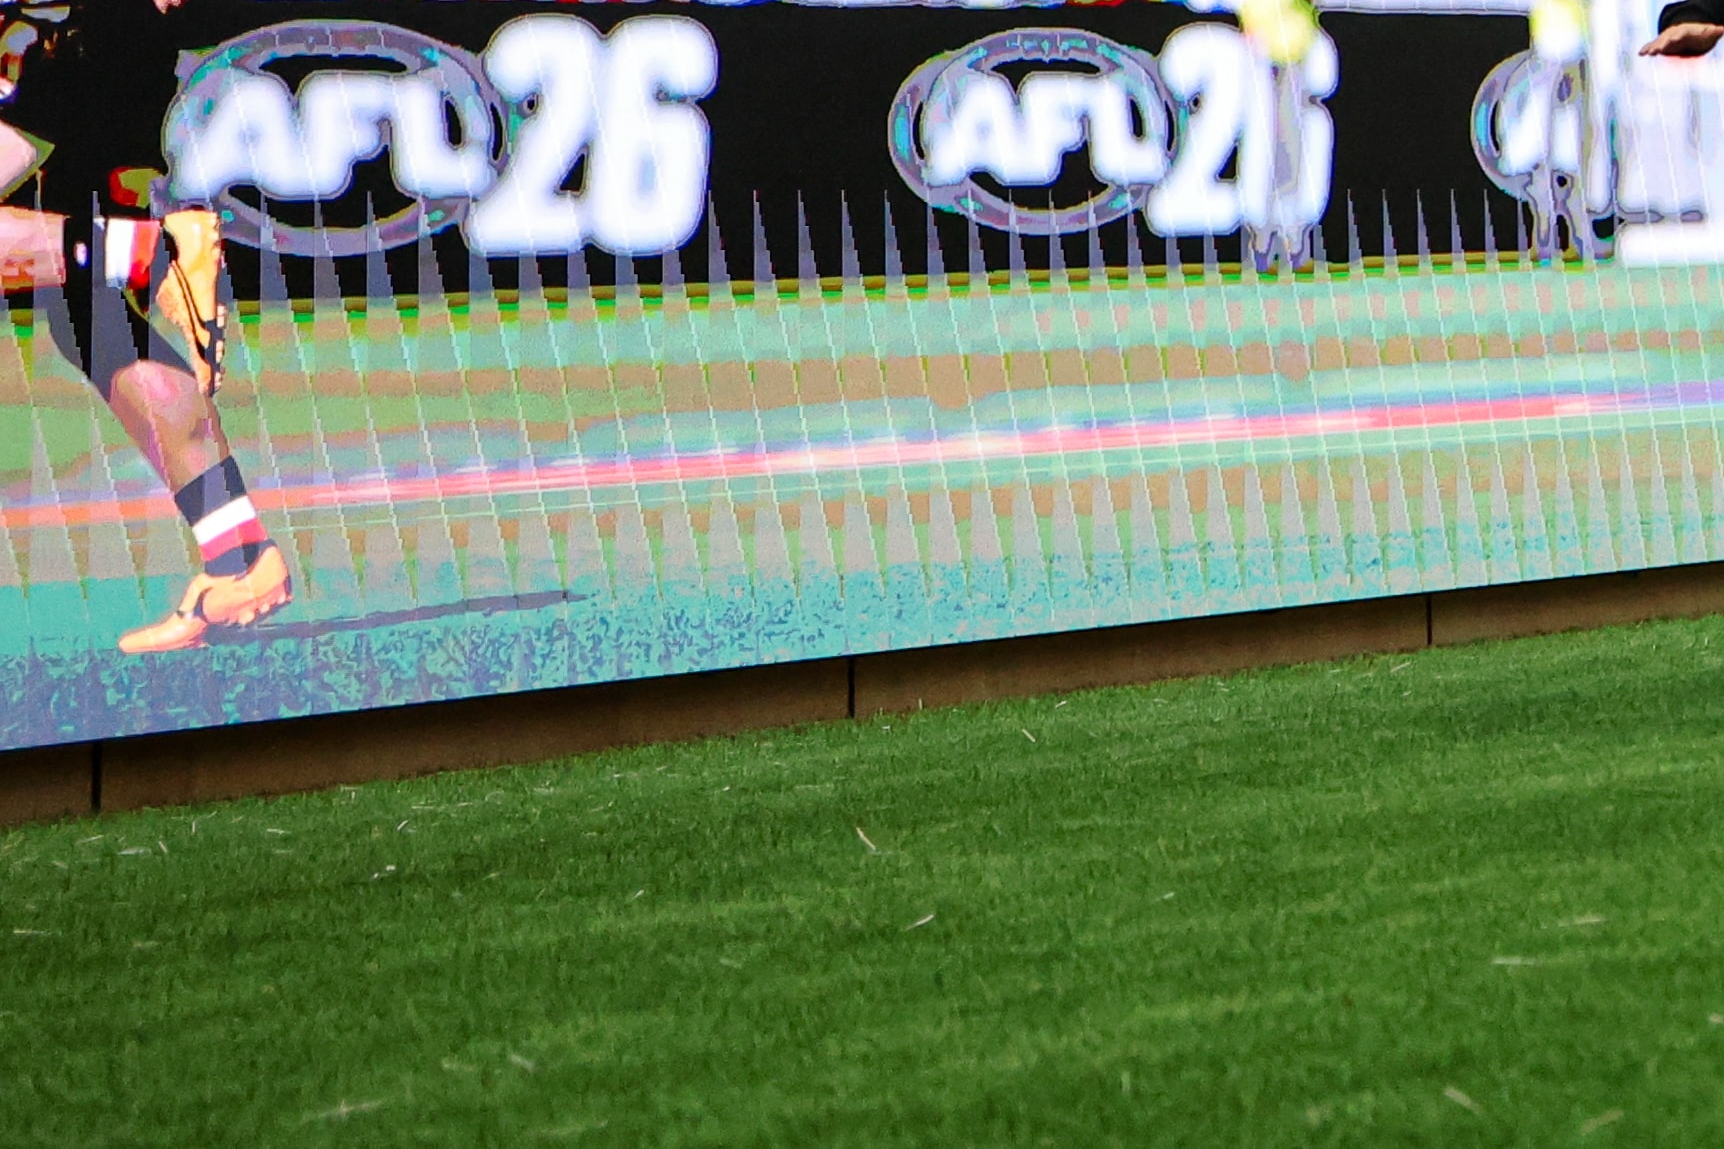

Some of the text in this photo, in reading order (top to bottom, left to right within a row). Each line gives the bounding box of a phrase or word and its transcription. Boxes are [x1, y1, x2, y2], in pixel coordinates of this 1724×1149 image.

[176, 13, 719, 256] AFL 26
[922, 72, 1169, 185] AFL
